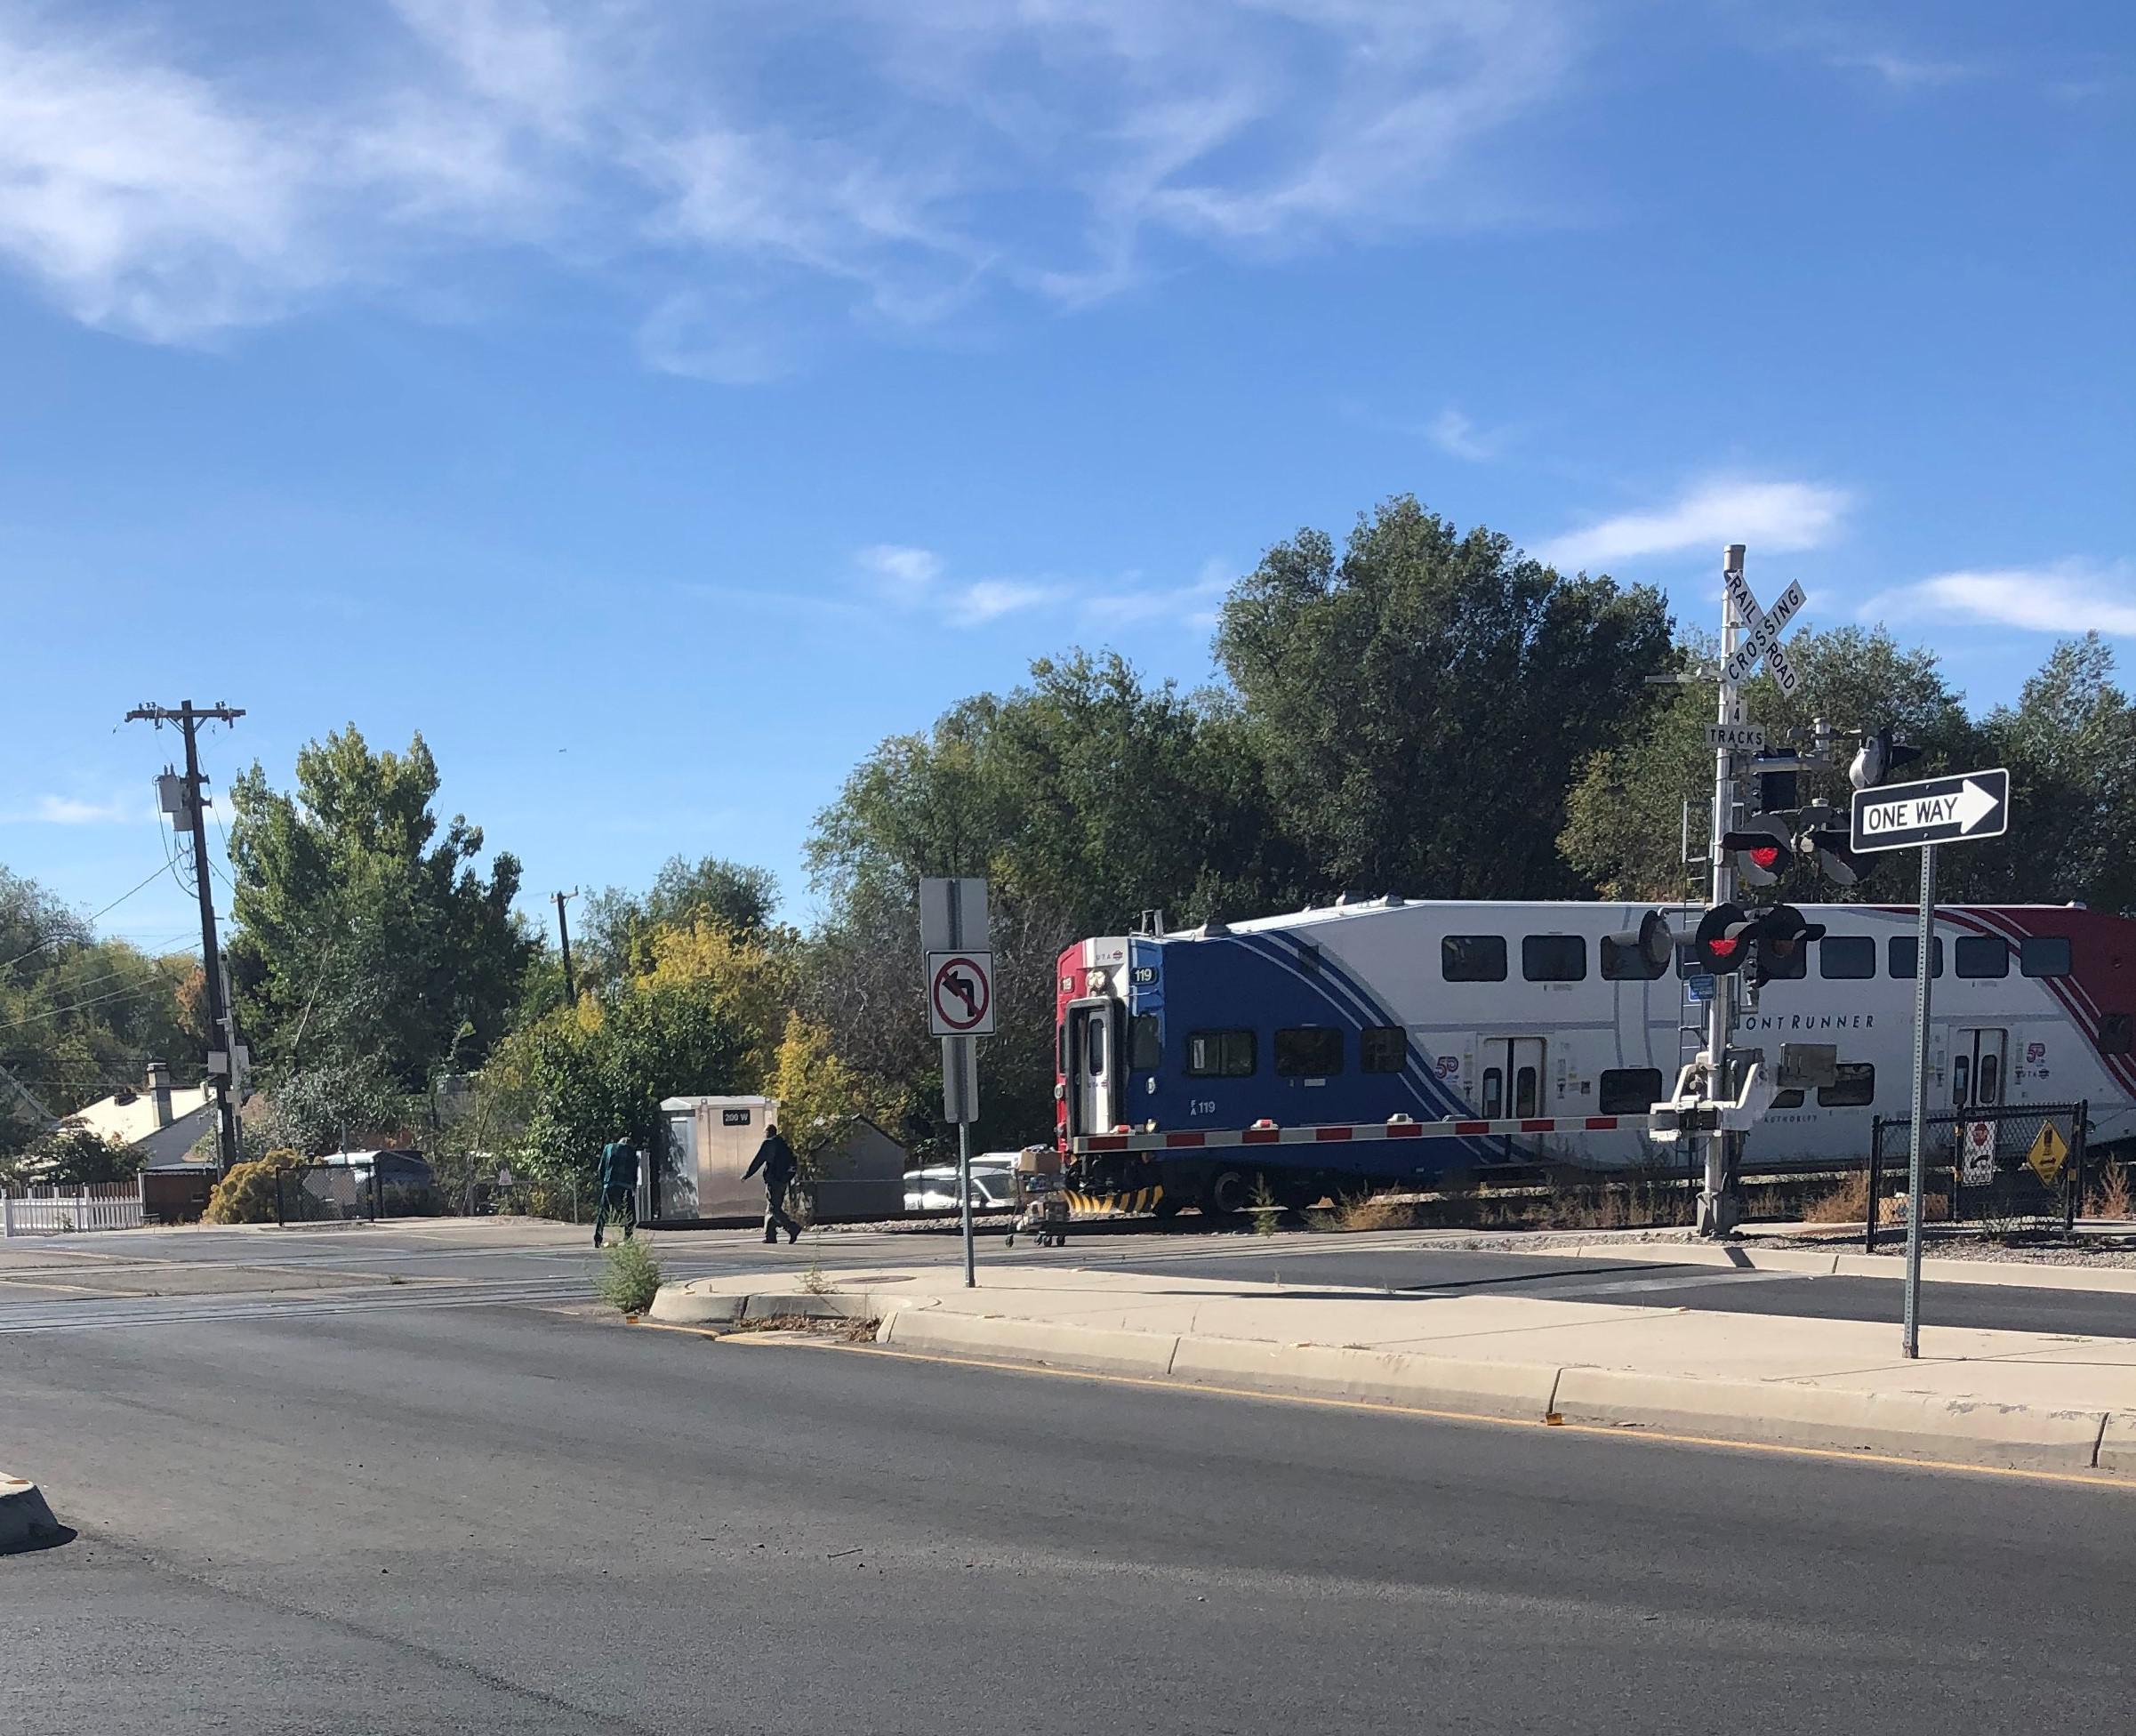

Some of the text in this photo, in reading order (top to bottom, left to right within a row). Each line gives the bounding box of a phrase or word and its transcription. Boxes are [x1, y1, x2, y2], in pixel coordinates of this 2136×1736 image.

[1728, 589, 1799, 680] CROSSING
[1730, 575, 1795, 689] RAIL ROAD
[1733, 707, 1740, 722] 4
[1710, 728, 1763, 745] TRACKS
[1868, 797, 1958, 831] ONE WAY
[1135, 968, 1152, 983] 119
[1746, 1015, 1875, 1031] ONTRUNNER
[1198, 1101, 1216, 1113] 119
